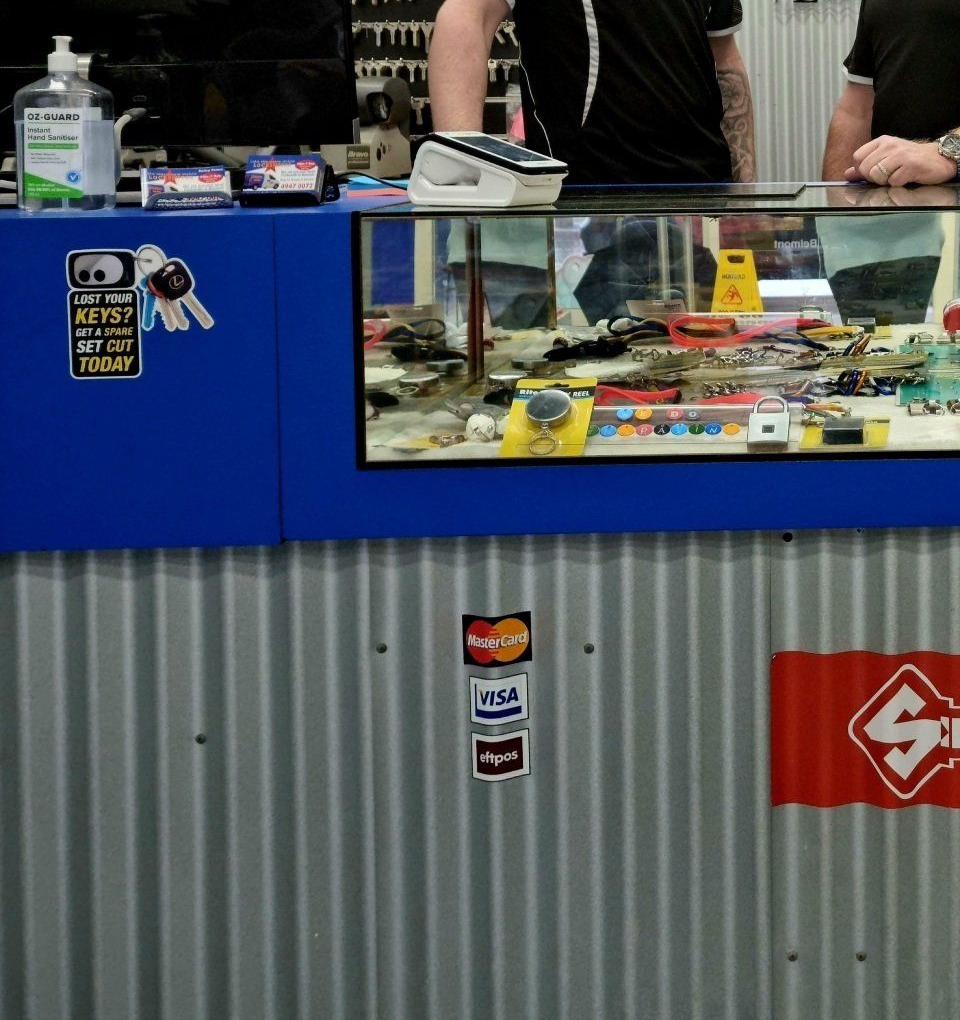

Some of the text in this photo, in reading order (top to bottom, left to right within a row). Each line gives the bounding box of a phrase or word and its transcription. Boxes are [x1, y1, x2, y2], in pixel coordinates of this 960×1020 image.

[27, 113, 80, 121] OZ-GUARD
[74, 293, 132, 305] LOST YOUR
[75, 307, 133, 325] KEYS?
[75, 327, 133, 337] GET A SPARE
[76, 339, 134, 354] SET CUT
[79, 356, 134, 373] TODAY
[572, 390, 590, 398] REEL
[467, 631, 527, 649] MasterCard
[479, 686, 519, 707] VISA
[480, 749, 518, 767] eftpos
